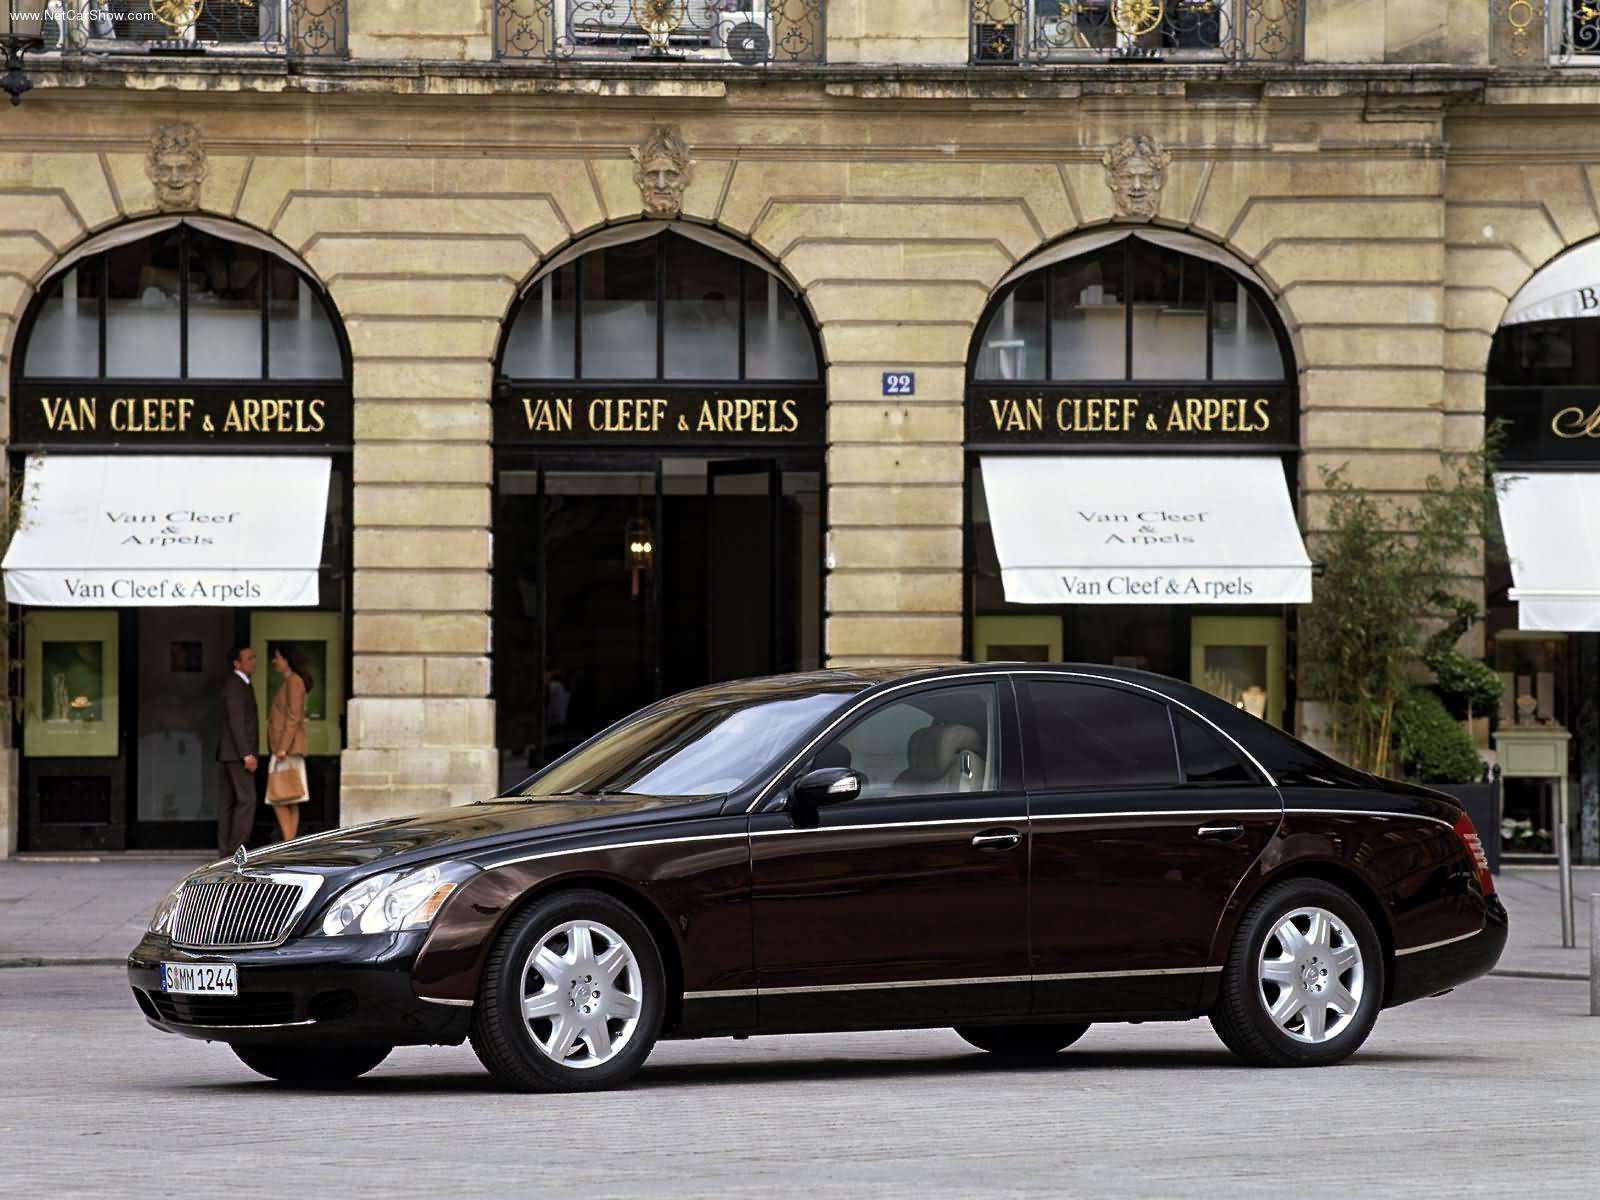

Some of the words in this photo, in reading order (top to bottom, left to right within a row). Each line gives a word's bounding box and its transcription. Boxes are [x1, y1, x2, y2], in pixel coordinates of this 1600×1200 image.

[887, 375, 911, 393] 22
[41, 397, 97, 432] VAN
[110, 397, 195, 432] CLEEF
[202, 414, 215, 432] &
[223, 398, 326, 433] ARPELS
[522, 398, 573, 432] VAN
[588, 398, 668, 432] CLEEF
[677, 414, 690, 432] &
[697, 398, 799, 433] ARPELS
[989, 397, 1043, 432] VAN
[1056, 397, 1139, 432] CLEEF
[1145, 413, 1158, 431] &
[1166, 398, 1270, 432] ARPELS
[106, 511, 156, 524] Van
[165, 510, 240, 524] Cleef
[1077, 511, 1129, 523] Van
[1137, 510, 1208, 523] Cleef
[161, 525, 180, 535] &
[1104, 532, 1195, 545] Arpels
[120, 534, 214, 547] Arpels
[64, 578, 105, 599] Van
[111, 578, 169, 599] Cleef
[171, 583, 186, 598] &
[190, 579, 262, 602] Arpels
[1061, 576, 1101, 596] Van
[1107, 576, 1163, 595] Cleef
[1165, 579, 1180, 595] &
[1183, 576, 1254, 599] Arpels
[197, 968, 233, 991] 1244
